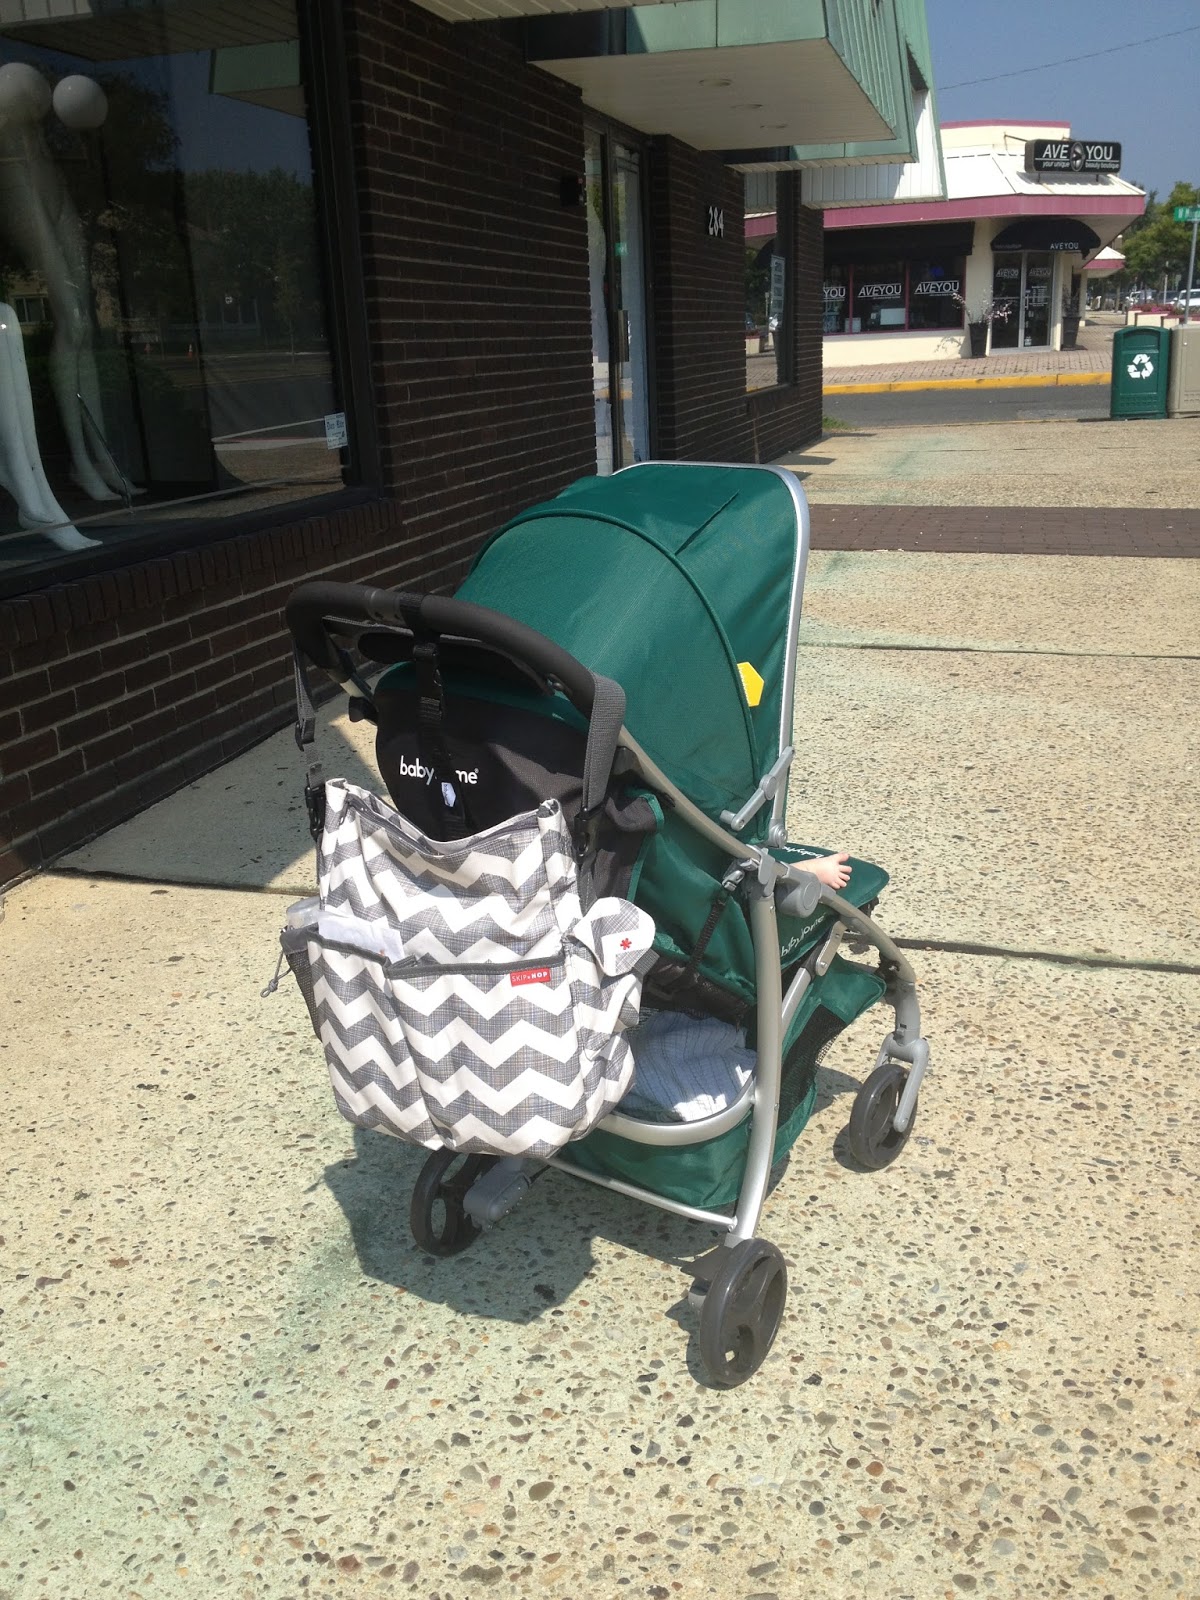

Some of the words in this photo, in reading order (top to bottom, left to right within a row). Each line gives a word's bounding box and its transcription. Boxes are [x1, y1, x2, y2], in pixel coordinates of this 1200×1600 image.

[1042, 144, 1069, 159] AVE
[1086, 145, 1113, 160] YOU
[708, 206, 724, 238] 284
[1050, 242, 1079, 250] AVEYOU
[823, 288, 846, 298] YOU
[858, 284, 902, 297] AVEYOU
[914, 282, 960, 293] AVEYOU
[400, 755, 478, 785] babyme
[531, 971, 548, 979] HOP
